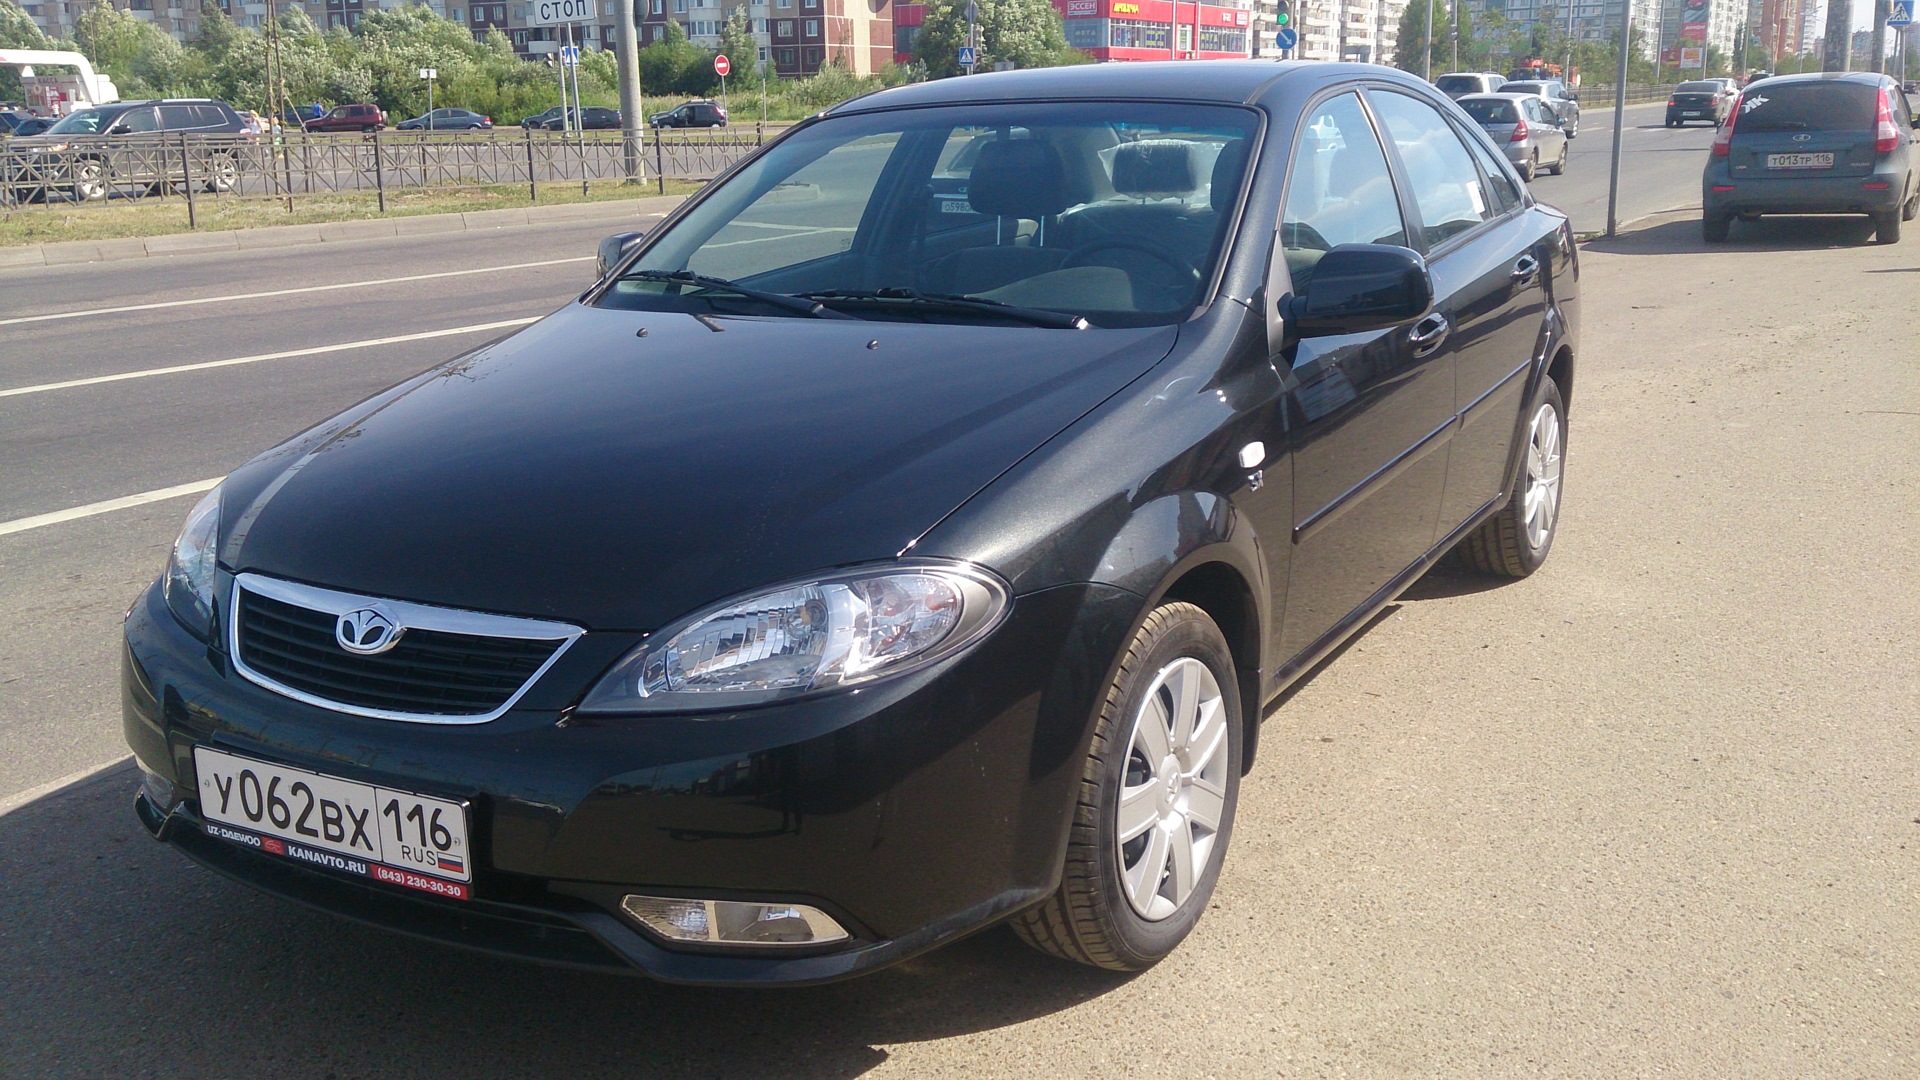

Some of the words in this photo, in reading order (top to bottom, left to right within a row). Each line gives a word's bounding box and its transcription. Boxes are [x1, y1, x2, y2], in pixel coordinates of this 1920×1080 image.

[541, 0, 586, 20] СТОП
[1070, 2, 1096, 10] ЭССЕН
[1814, 154, 1832, 162] 116
[383, 798, 452, 851] 116
[207, 824, 261, 847] UZ-DAEWOO
[287, 845, 367, 875] KANAVTO.RU
[377, 867, 405, 884] (843)
[407, 875, 461, 896] 230-30-30
[401, 845, 436, 866] RUS
